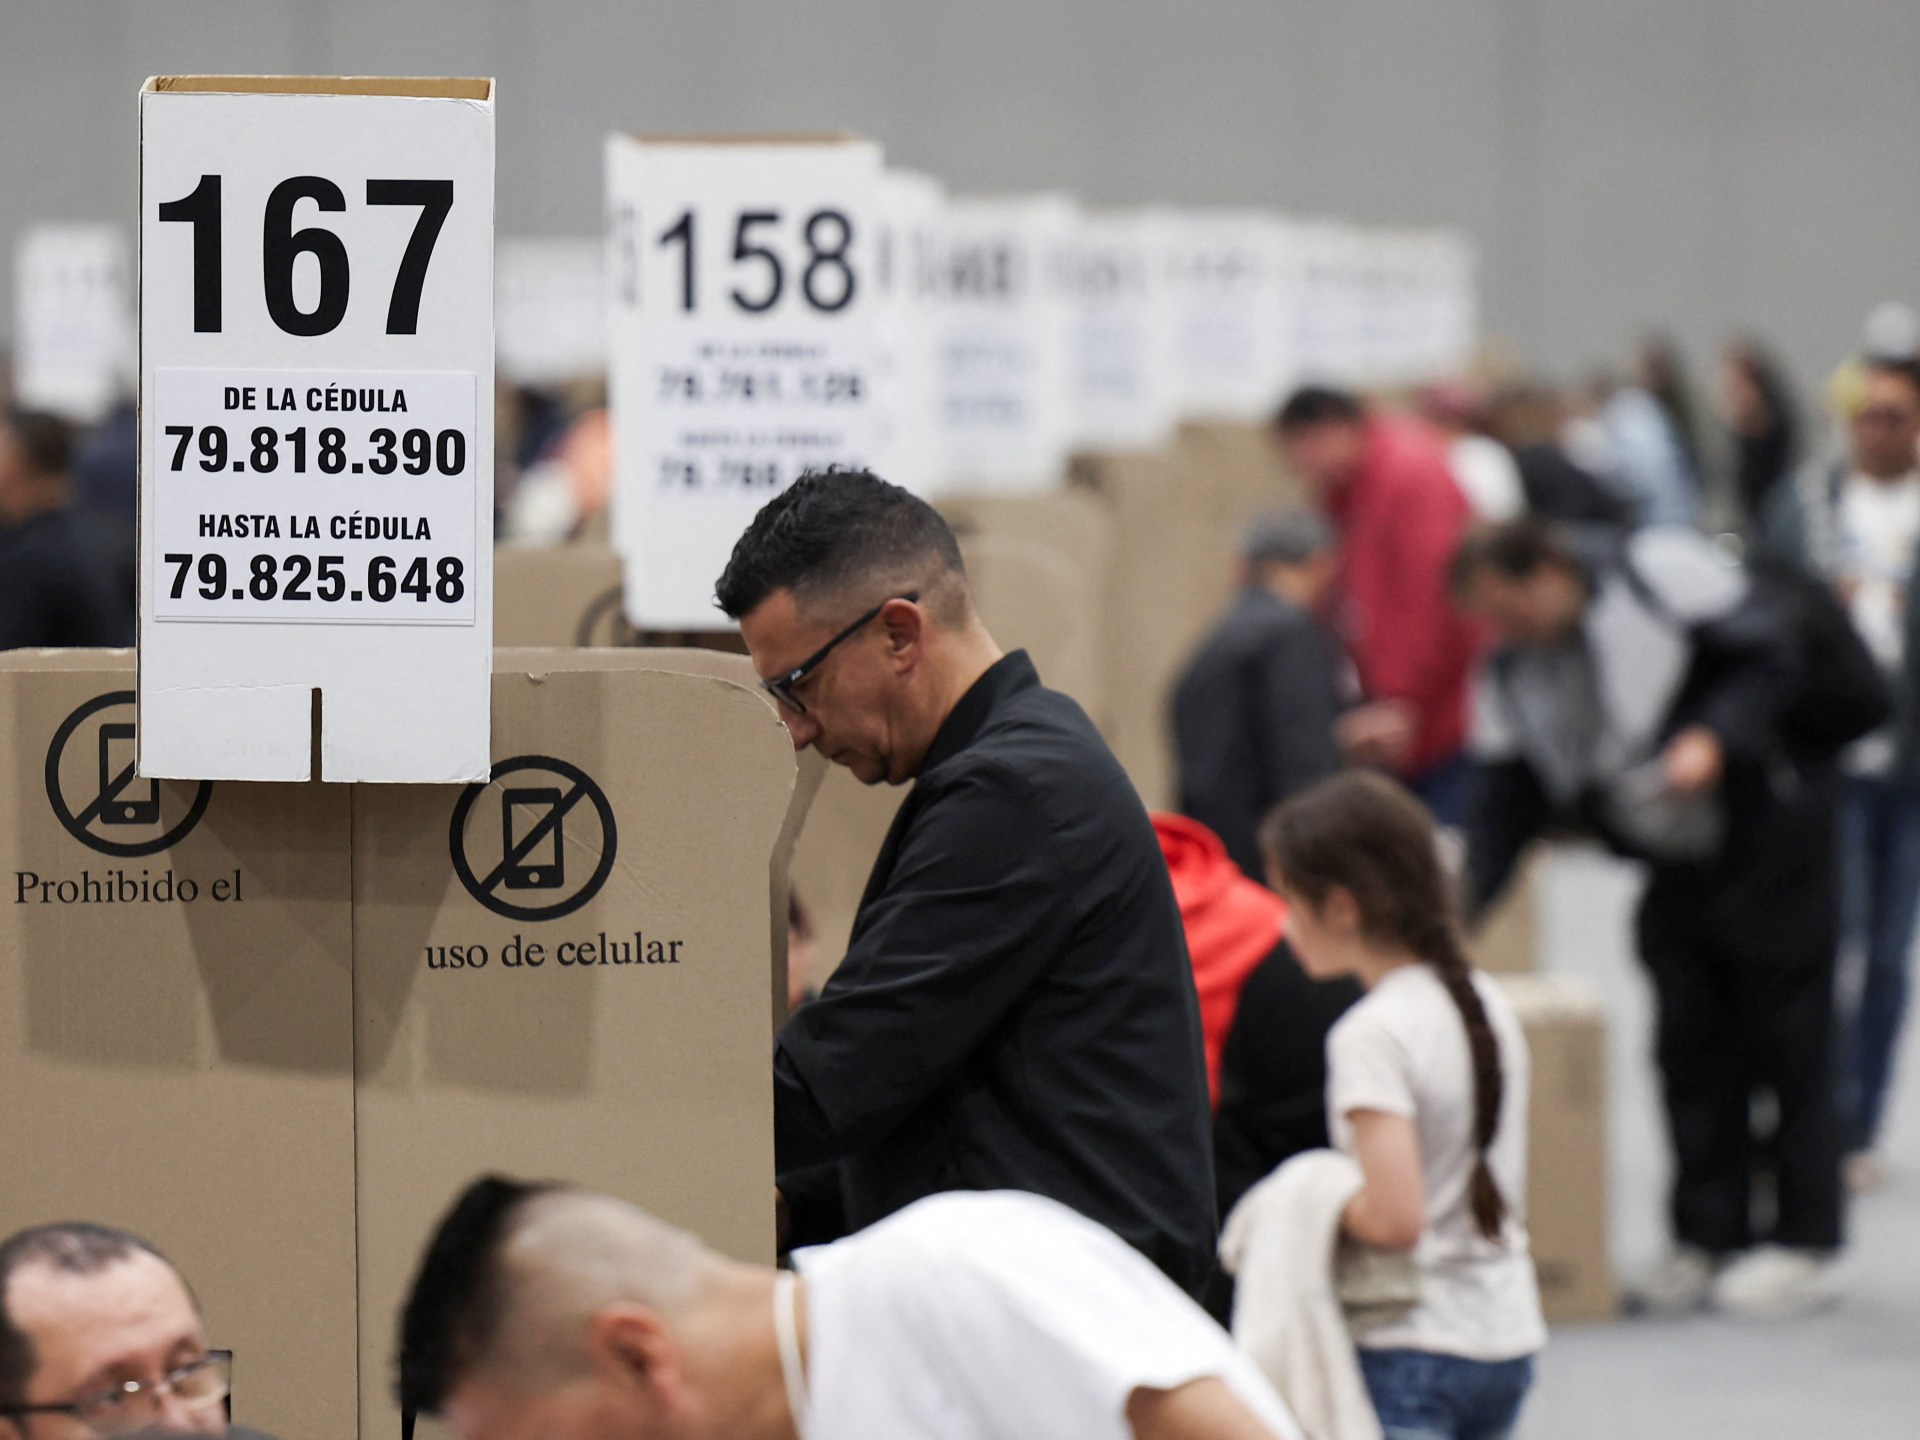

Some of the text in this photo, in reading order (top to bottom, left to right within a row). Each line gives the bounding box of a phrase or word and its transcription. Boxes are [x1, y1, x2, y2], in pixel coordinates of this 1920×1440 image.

[158, 174, 454, 337] 167
[657, 207, 858, 315] 158
[224, 382, 408, 413] DE LA CÉDULA
[164, 425, 466, 476] 79.818.390
[199, 510, 432, 541] HASTA LA CÉDULA
[164, 553, 465, 604] 79.825.648
[14, 868, 244, 904] Prohibido el
[424, 930, 684, 970] uso de celular
